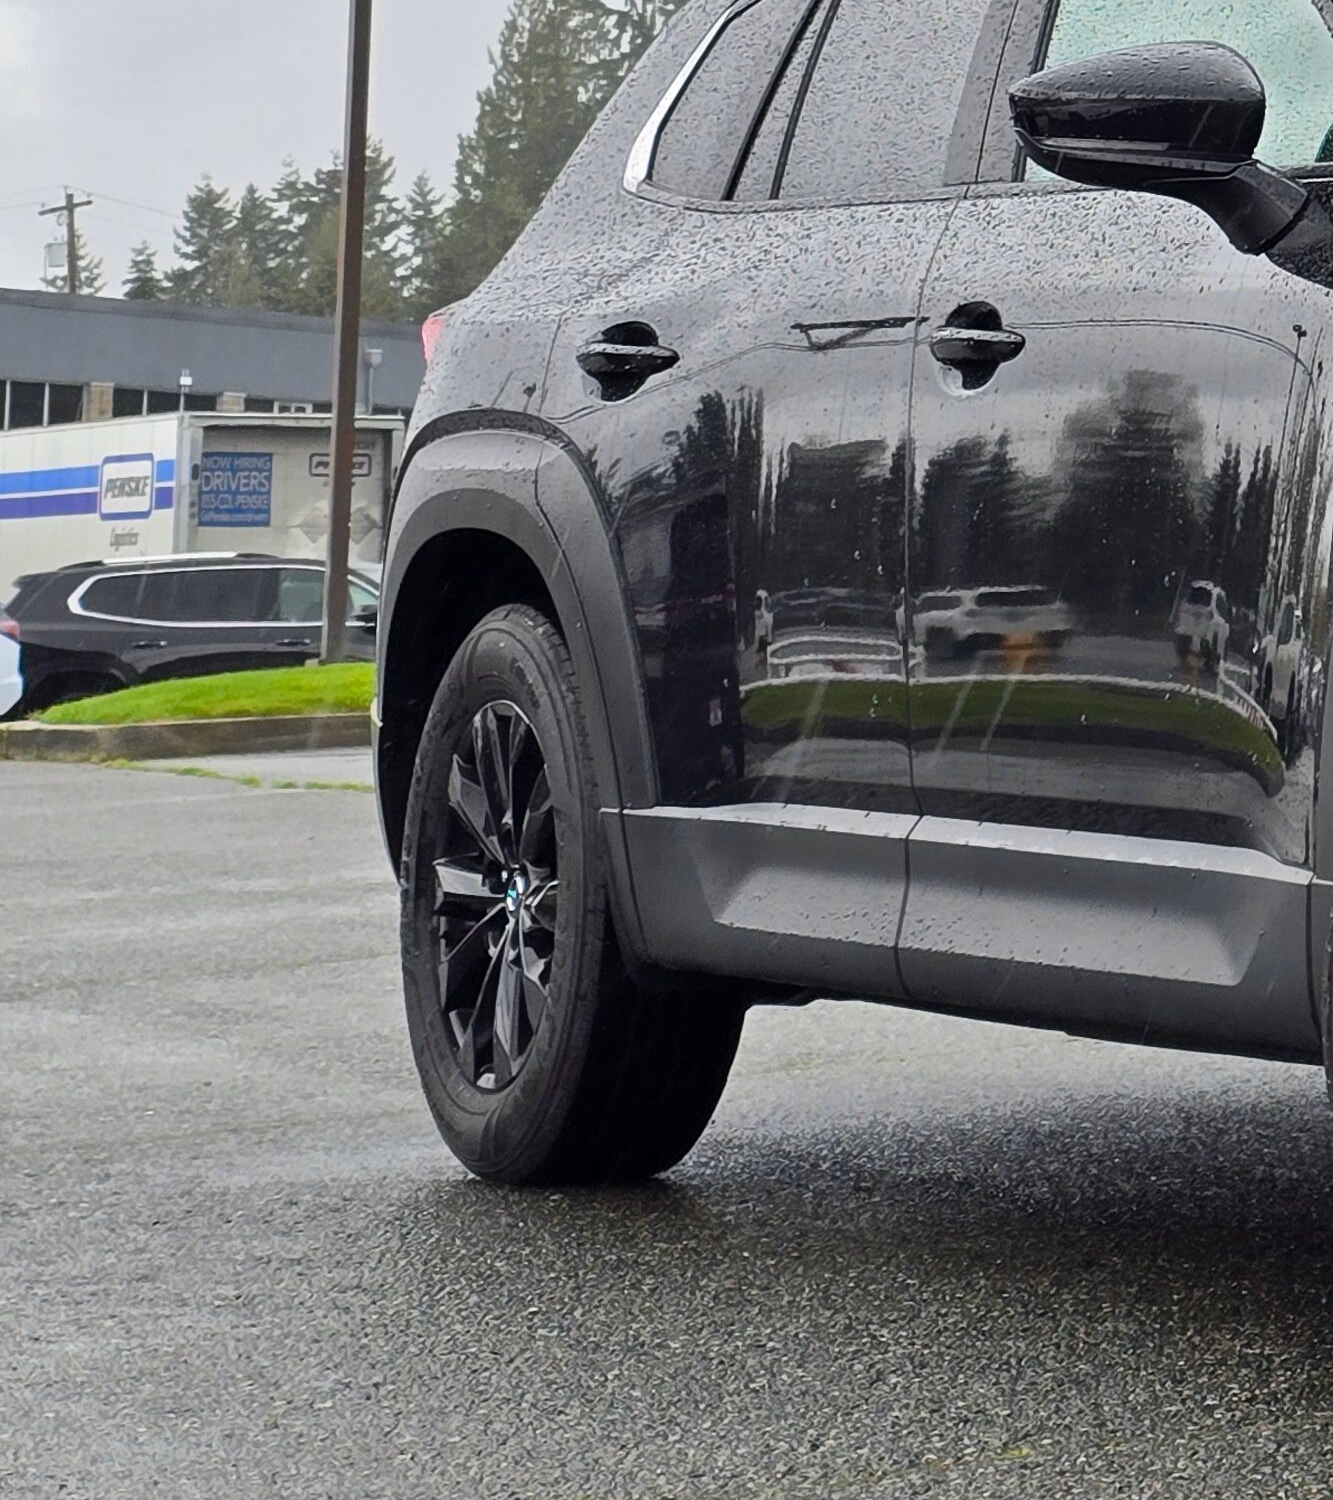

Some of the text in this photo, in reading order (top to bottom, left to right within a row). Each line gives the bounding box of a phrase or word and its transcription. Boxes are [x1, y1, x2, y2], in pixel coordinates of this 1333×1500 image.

[202, 456, 271, 469] NOW HIRING
[104, 476, 150, 499] PENSKE
[202, 471, 270, 492] DRIVERS
